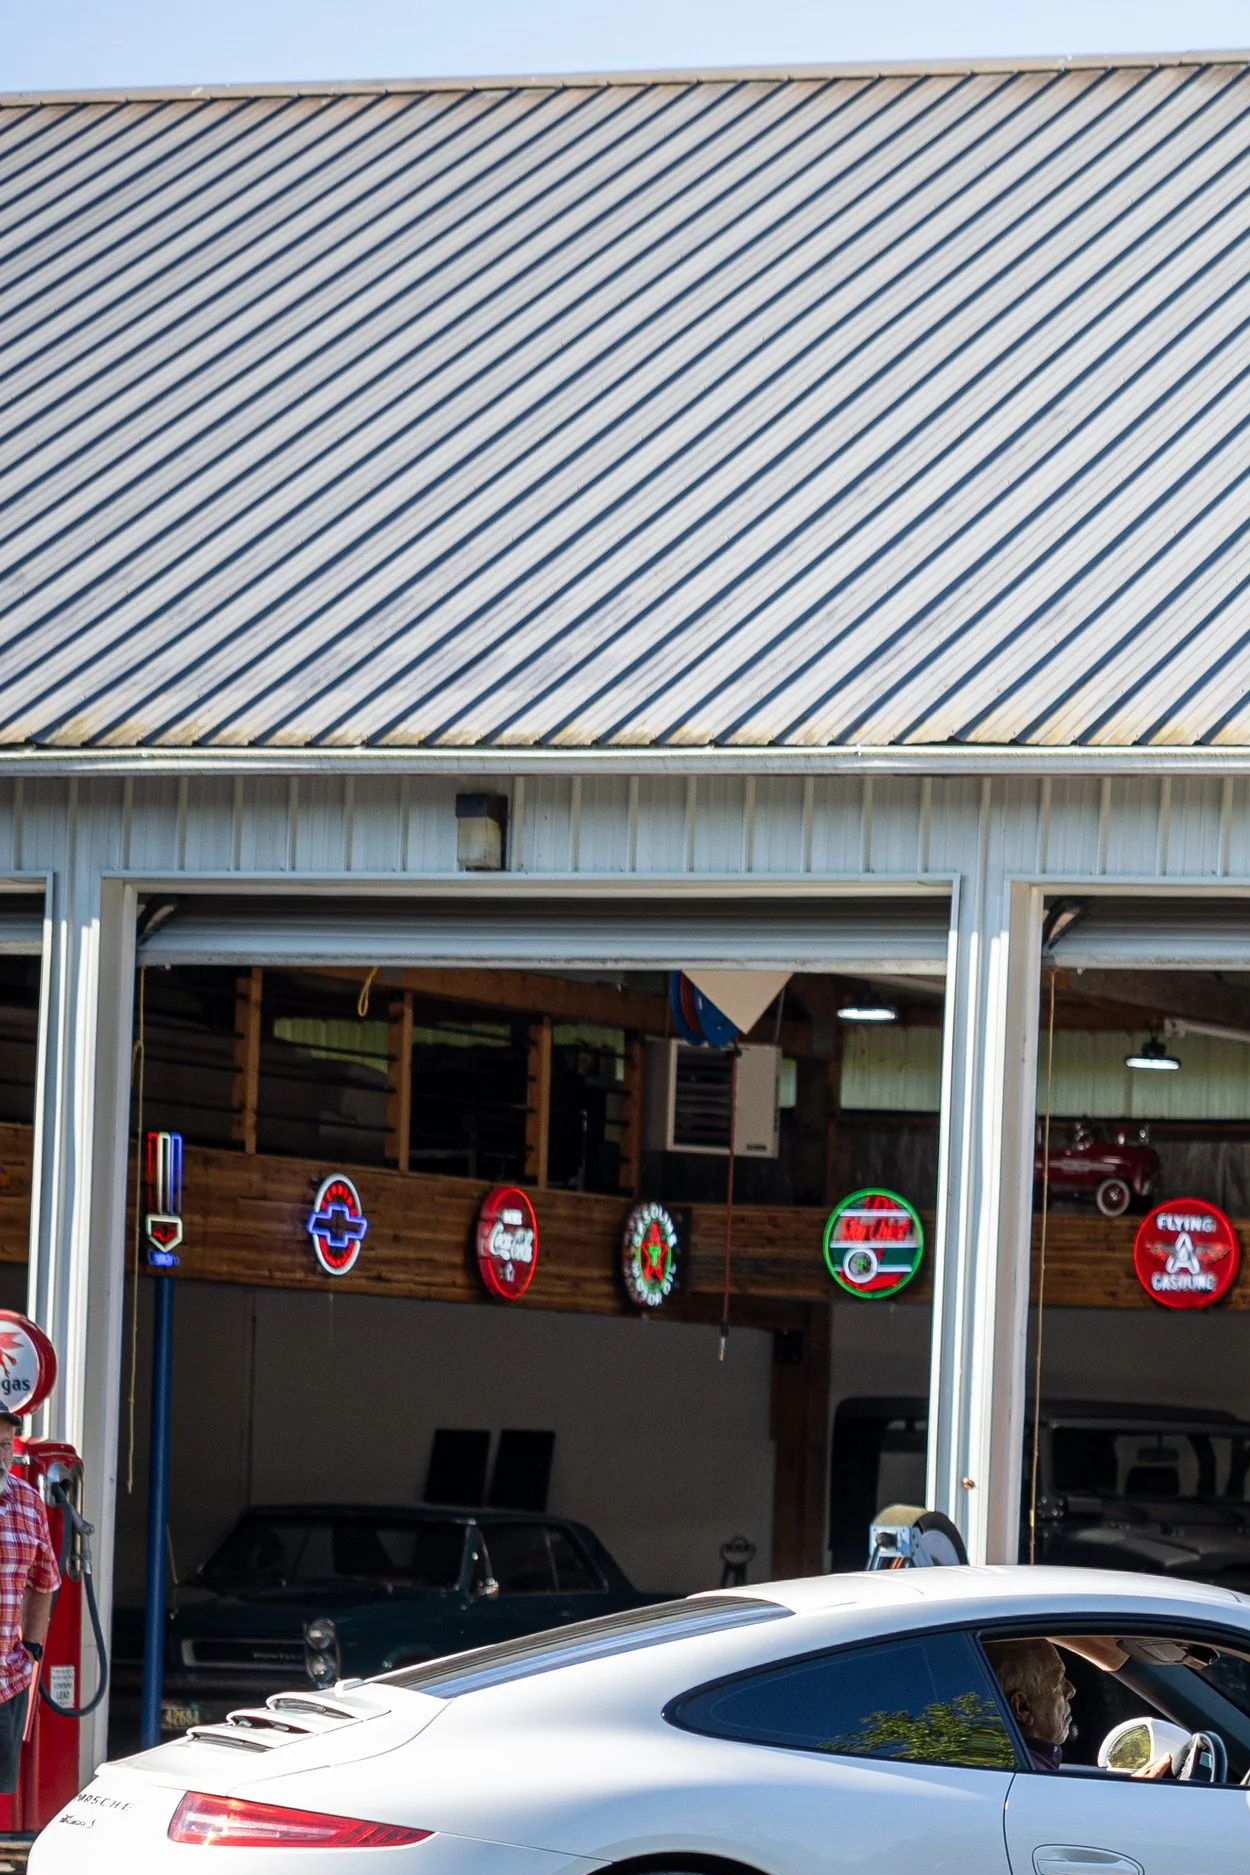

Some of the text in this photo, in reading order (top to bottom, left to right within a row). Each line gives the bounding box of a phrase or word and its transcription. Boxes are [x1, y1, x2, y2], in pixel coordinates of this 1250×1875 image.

[1156, 1212, 1217, 1233] FLYING
[1165, 1230, 1201, 1275] A
[1150, 1271, 1218, 1293] GASOLINE
